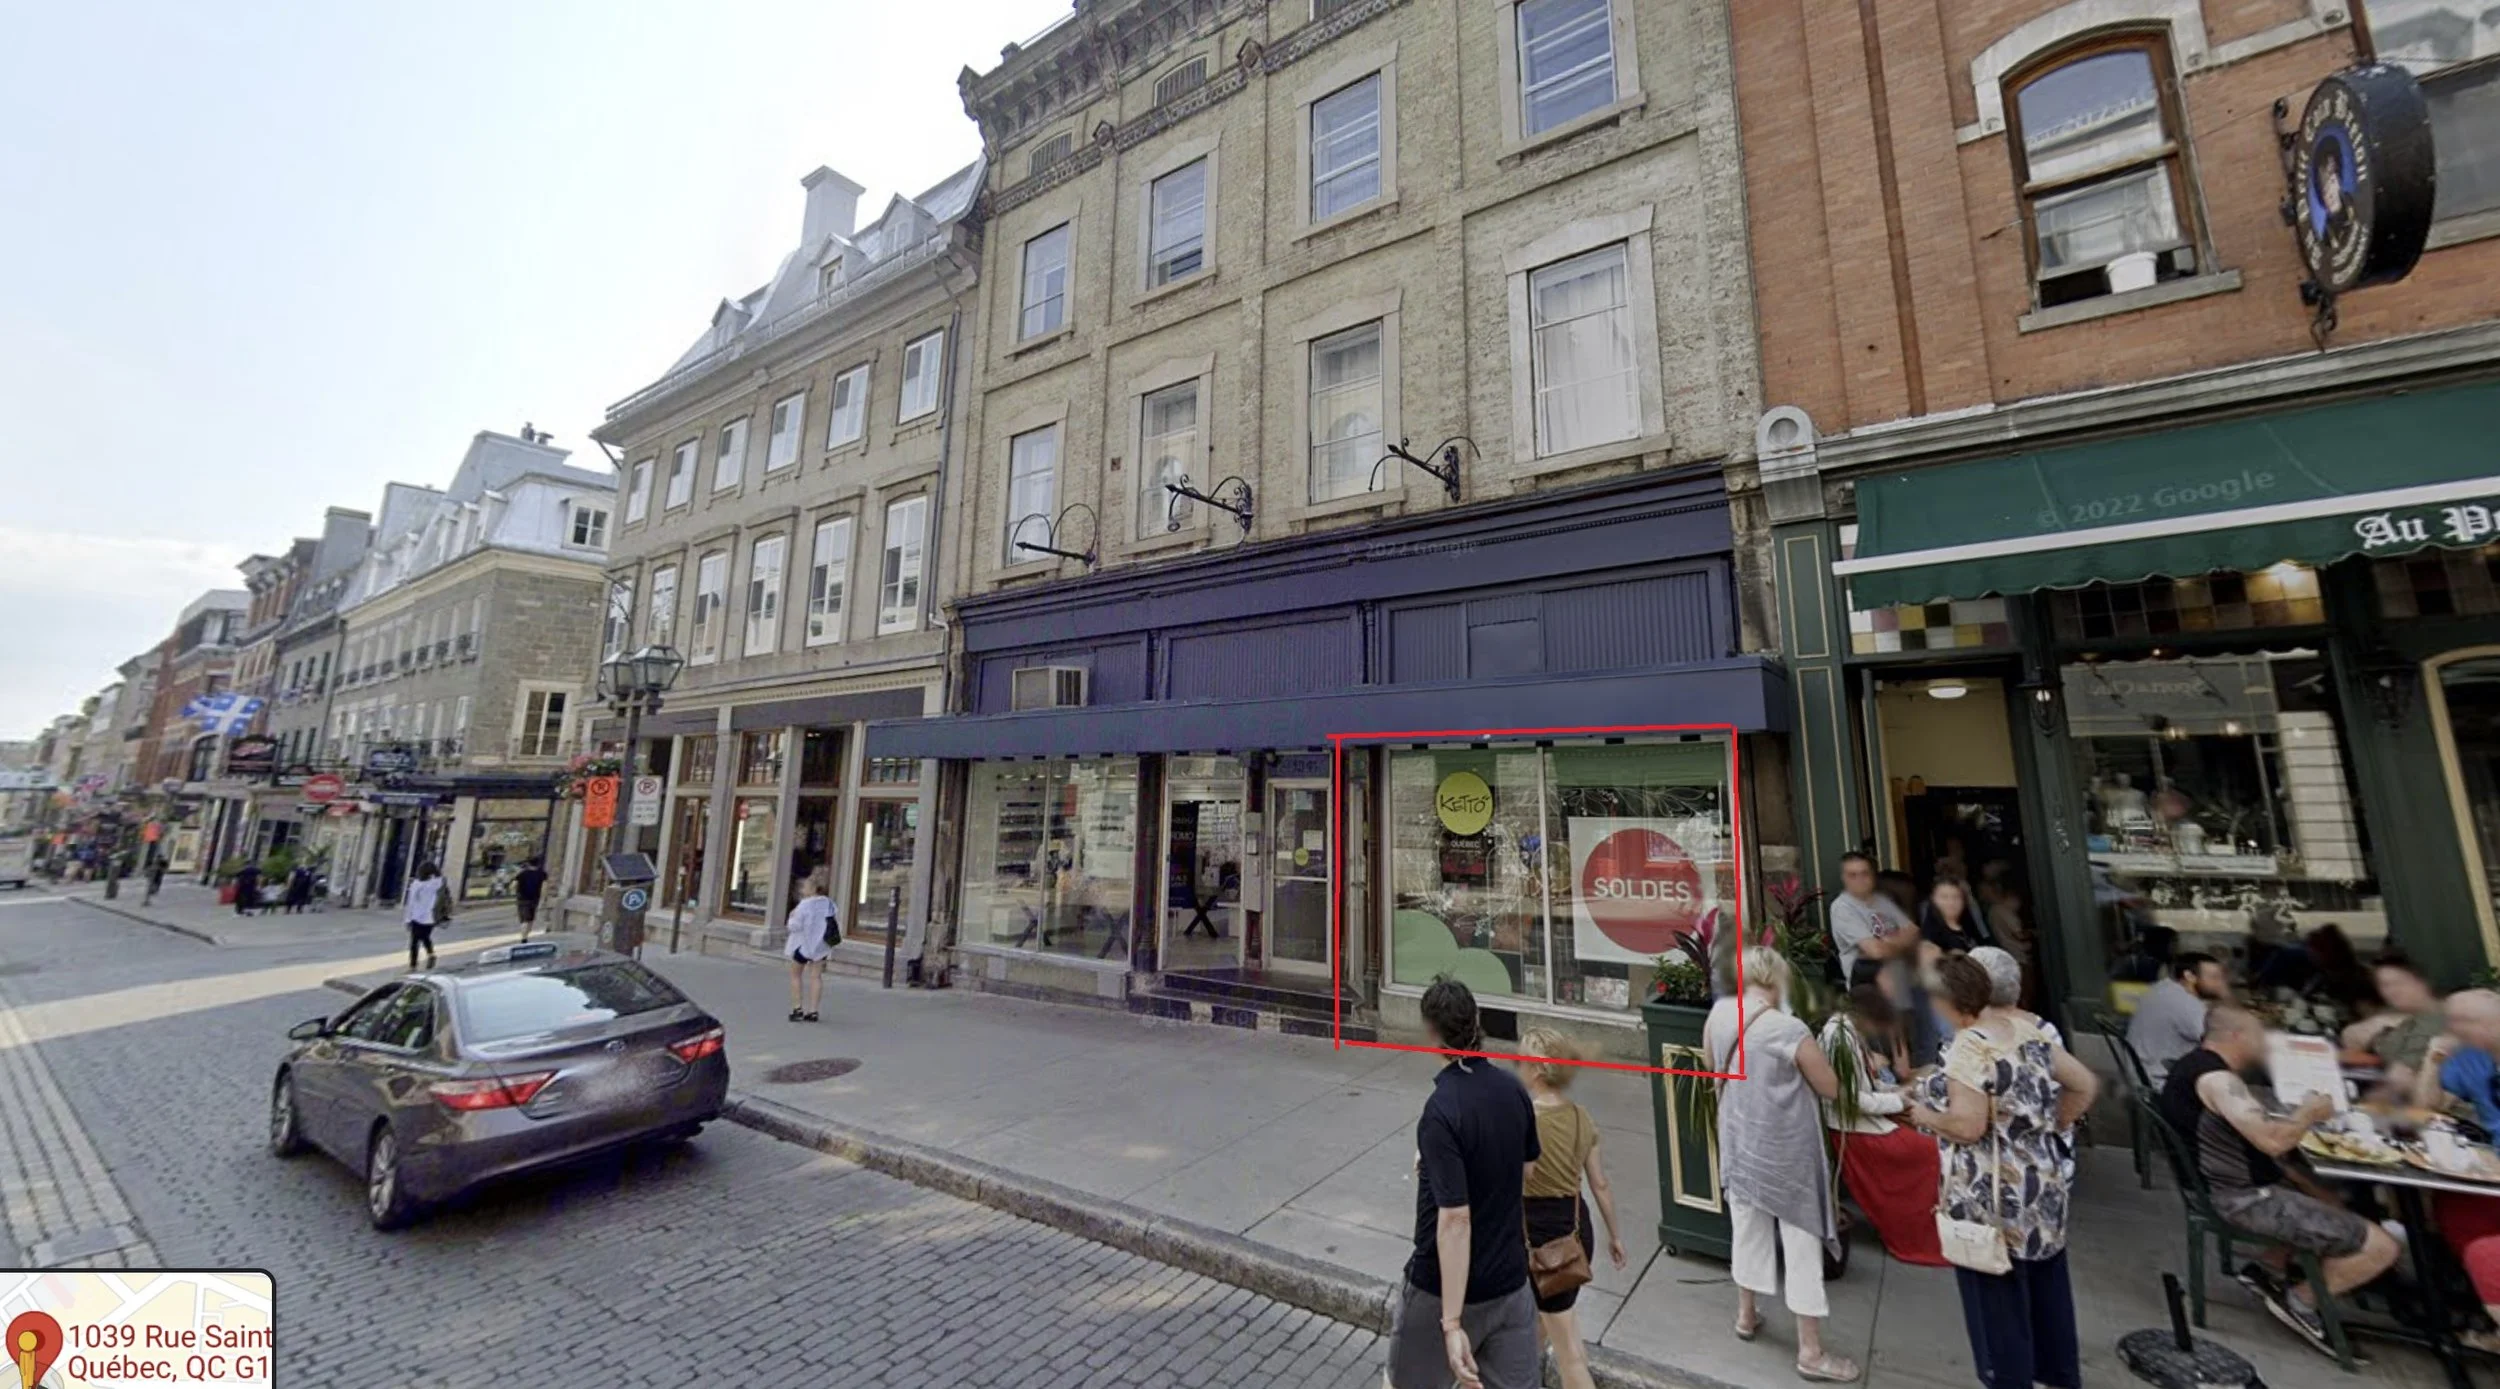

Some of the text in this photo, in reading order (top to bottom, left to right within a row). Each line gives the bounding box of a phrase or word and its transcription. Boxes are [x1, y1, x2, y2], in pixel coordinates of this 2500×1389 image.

[2353, 504, 2500, 550] Au P
[1593, 876, 1692, 902] SOLDES
